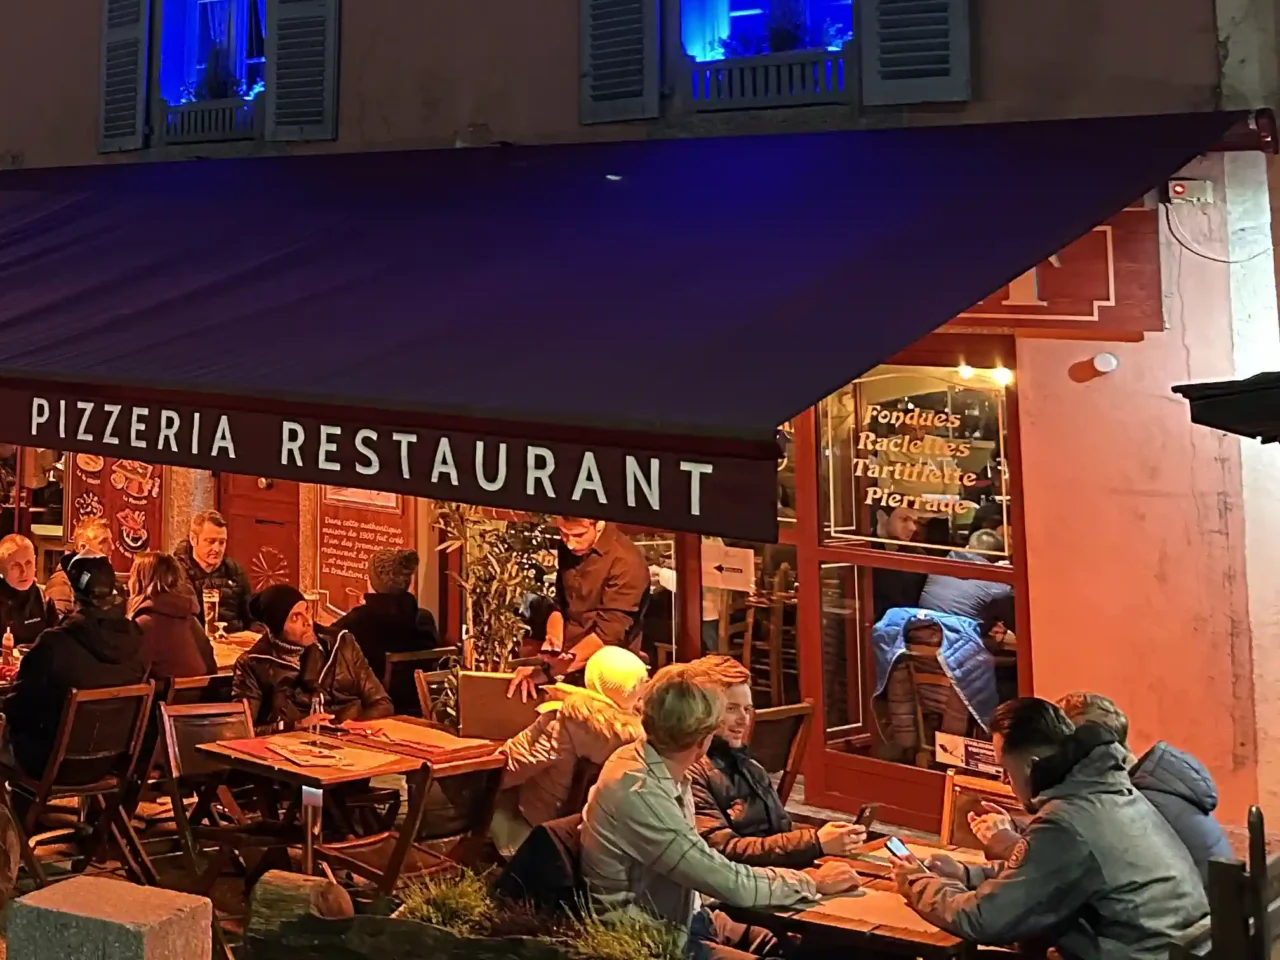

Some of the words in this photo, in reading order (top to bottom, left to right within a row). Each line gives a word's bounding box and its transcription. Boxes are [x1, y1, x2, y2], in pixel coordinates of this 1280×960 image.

[862, 404, 962, 428] Fondues
[31, 397, 237, 459] PIZZERIA
[280, 420, 714, 516] RESTAURANT
[857, 431, 972, 457] Raclettes
[864, 487, 969, 514] Pierrade
[359, 531, 375, 541] 1900
